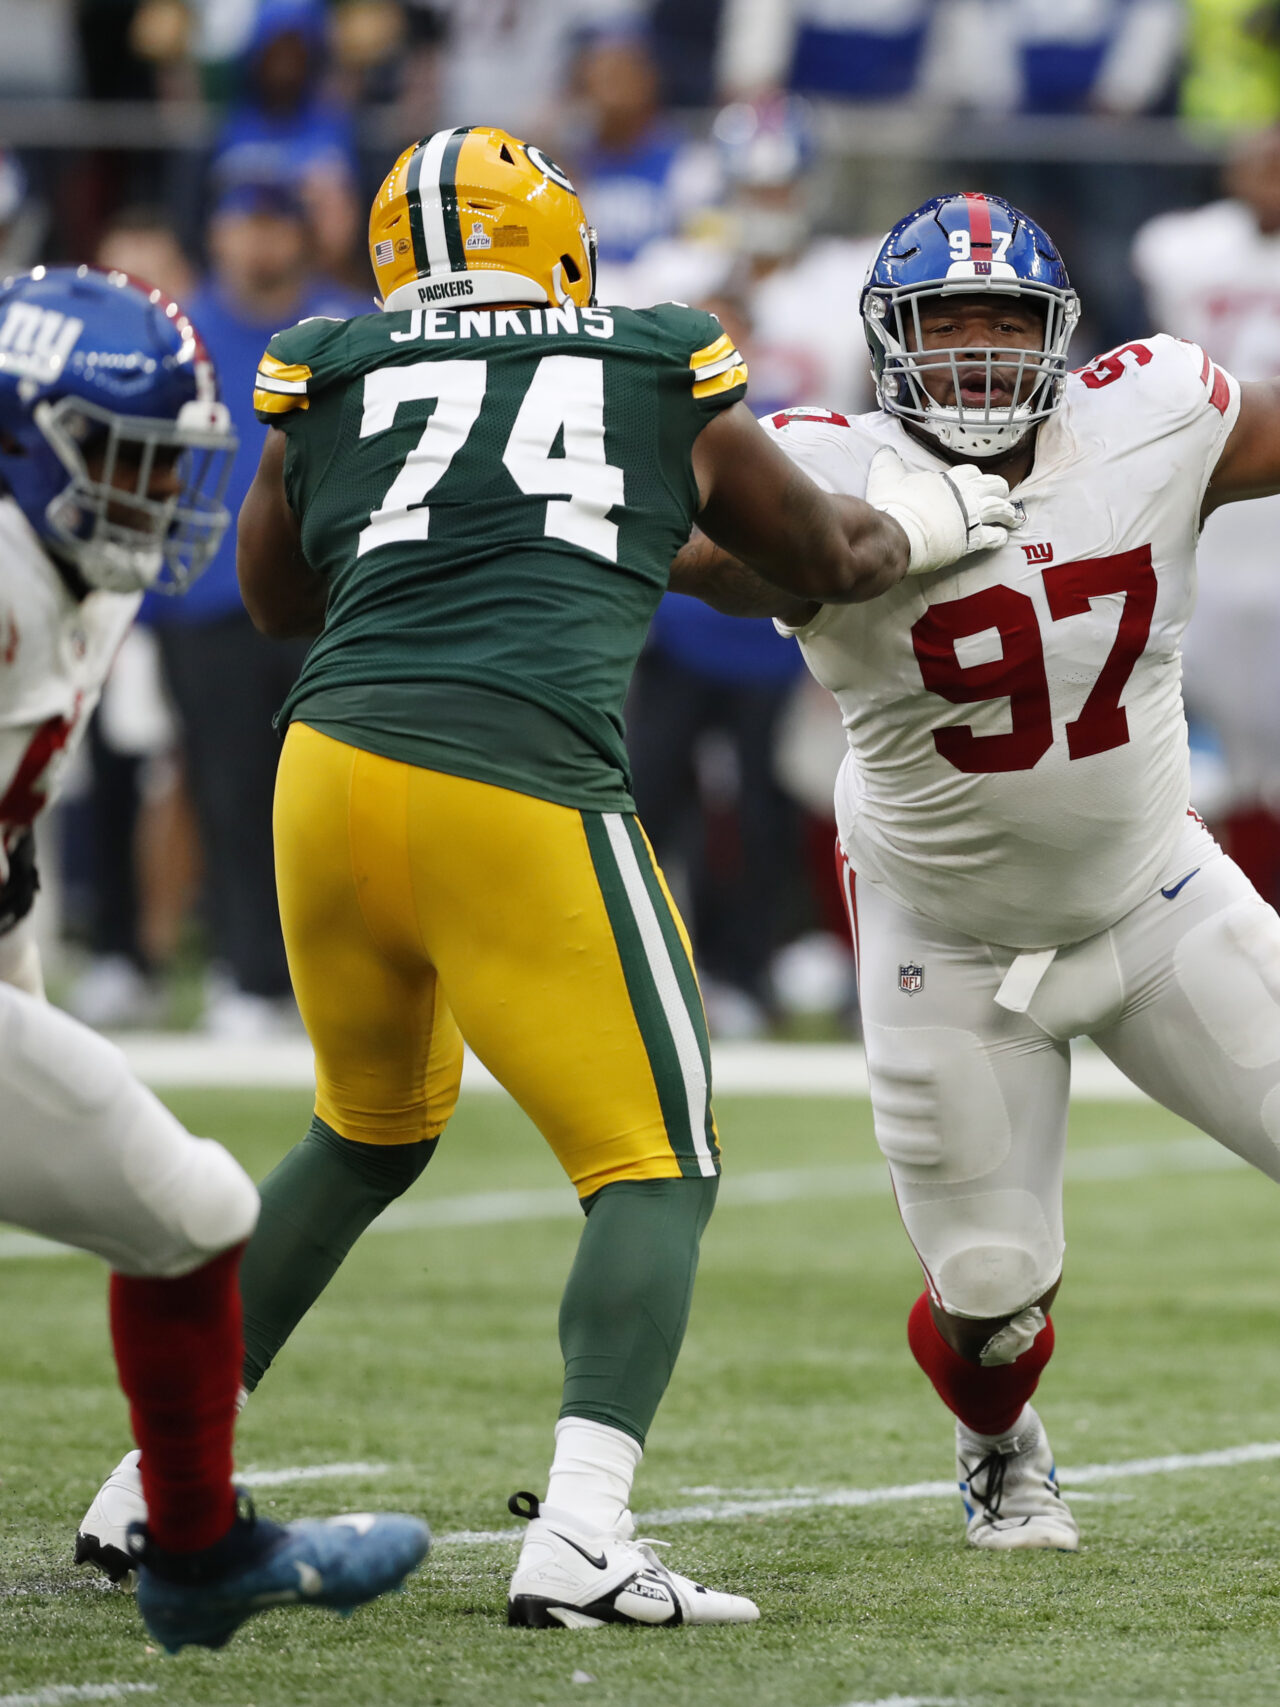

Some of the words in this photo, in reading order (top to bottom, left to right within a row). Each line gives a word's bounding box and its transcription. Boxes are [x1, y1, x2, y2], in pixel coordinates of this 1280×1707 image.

[467, 238, 490, 246] CATCH
[417, 279, 474, 303] PACKERS
[390, 306, 614, 343] JENKINS
[357, 355, 625, 563] 74
[1021, 542, 1053, 566] ny
[910, 543, 1158, 773] 97
[902, 976, 920, 989] NFL
[624, 1582, 667, 1601] ALPHA
